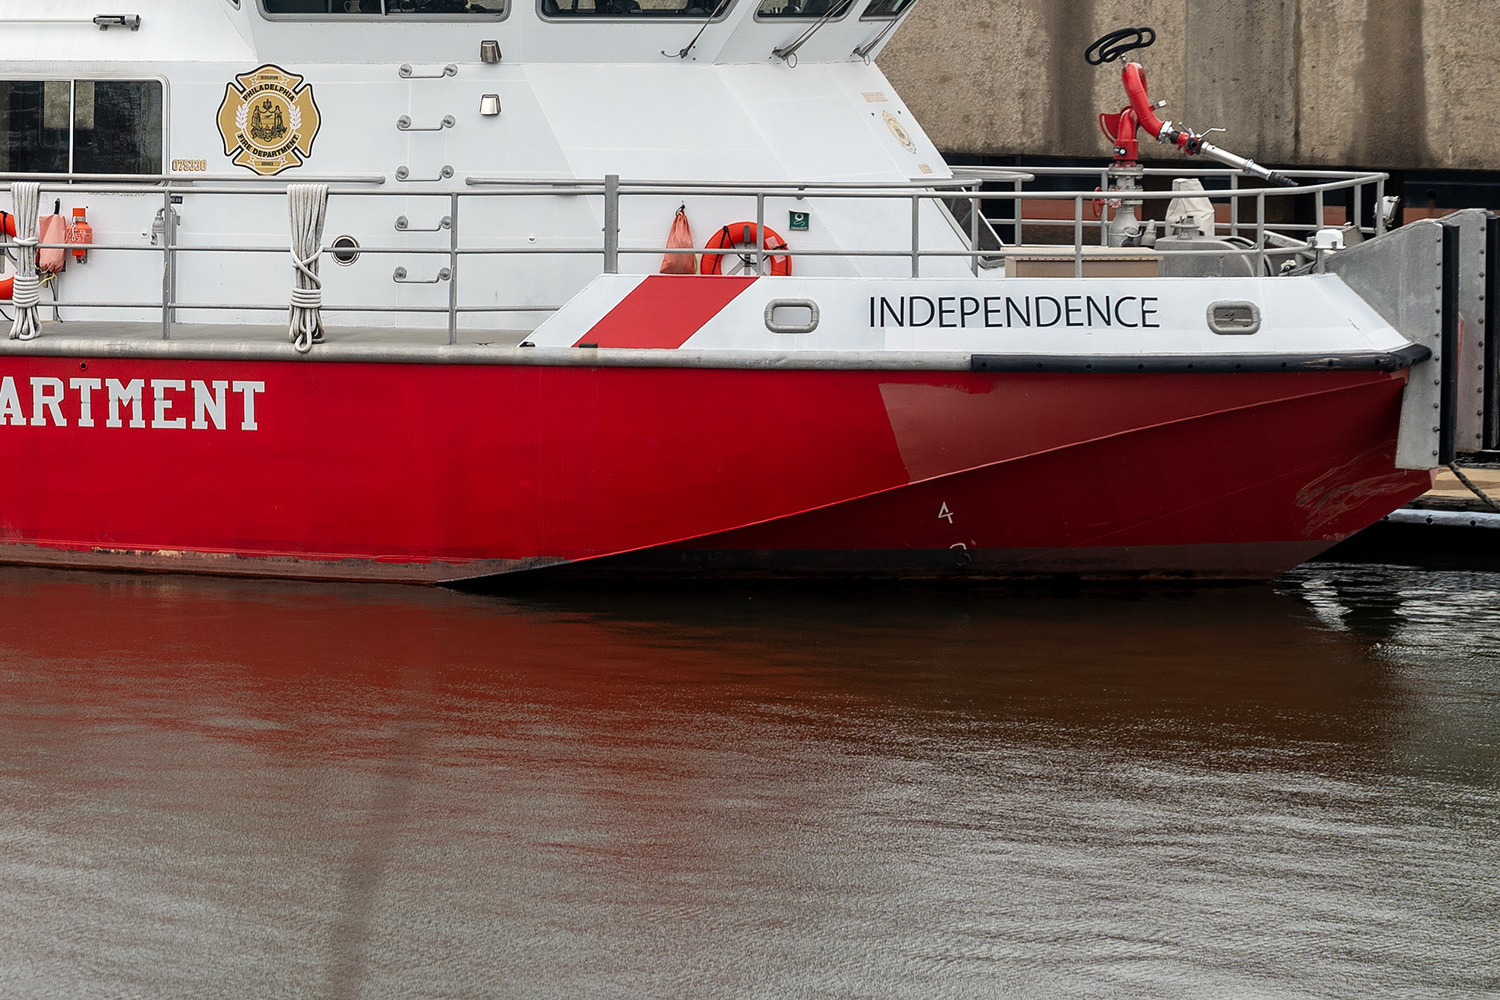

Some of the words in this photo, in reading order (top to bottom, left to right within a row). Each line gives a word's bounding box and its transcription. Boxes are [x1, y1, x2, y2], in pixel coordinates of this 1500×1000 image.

[242, 83, 297, 103] PHILADELPHIA
[237, 133, 252, 152] FIRE
[252, 134, 300, 158] DEPARTMENT
[171, 159, 208, 172] 075330
[869, 295, 1161, 329] INDEPENDENCE
[938, 501, 954, 524] 4
